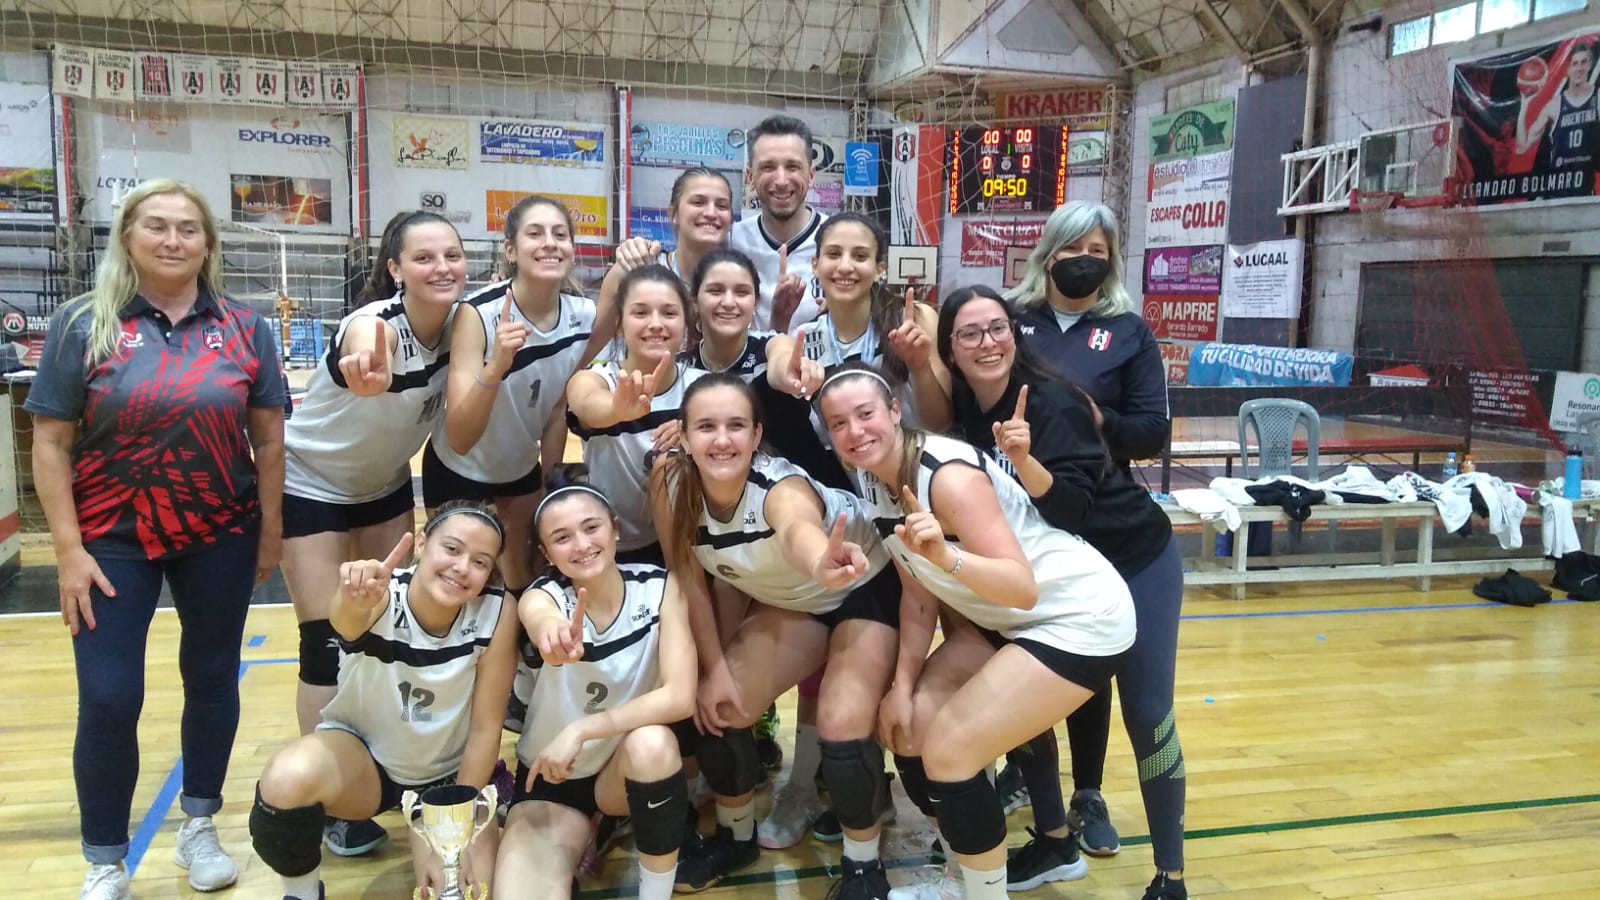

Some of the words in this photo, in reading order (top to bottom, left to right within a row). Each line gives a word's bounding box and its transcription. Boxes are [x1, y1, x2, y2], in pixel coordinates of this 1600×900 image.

[1008, 91, 1103, 116] KRAKER
[1560, 110, 1596, 127] ARGENTINA
[239, 129, 331, 148] EXPLORER
[483, 123, 563, 138] LAVADERO
[984, 131, 999, 144] 00
[1016, 129, 1032, 143] 00
[1568, 129, 1583, 149] 10
[653, 135, 722, 156] PISCINAS
[983, 156, 991, 170] 0
[1022, 155, 1031, 169] 0
[984, 179, 1027, 197] 09:50
[1521, 171, 1583, 195] BOLMARO
[1150, 205, 1182, 223] ESCAPES
[1182, 200, 1226, 229] COLLA
[1245, 251, 1289, 268] LUCAAL
[1162, 301, 1216, 322] MAPFRE
[1200, 348, 1217, 364] TU
[1273, 360, 1293, 379] DE
[1293, 361, 1336, 384] VIDA
[528, 379, 540, 408] 1
[397, 680, 435, 722] 12
[584, 681, 609, 715] 2
